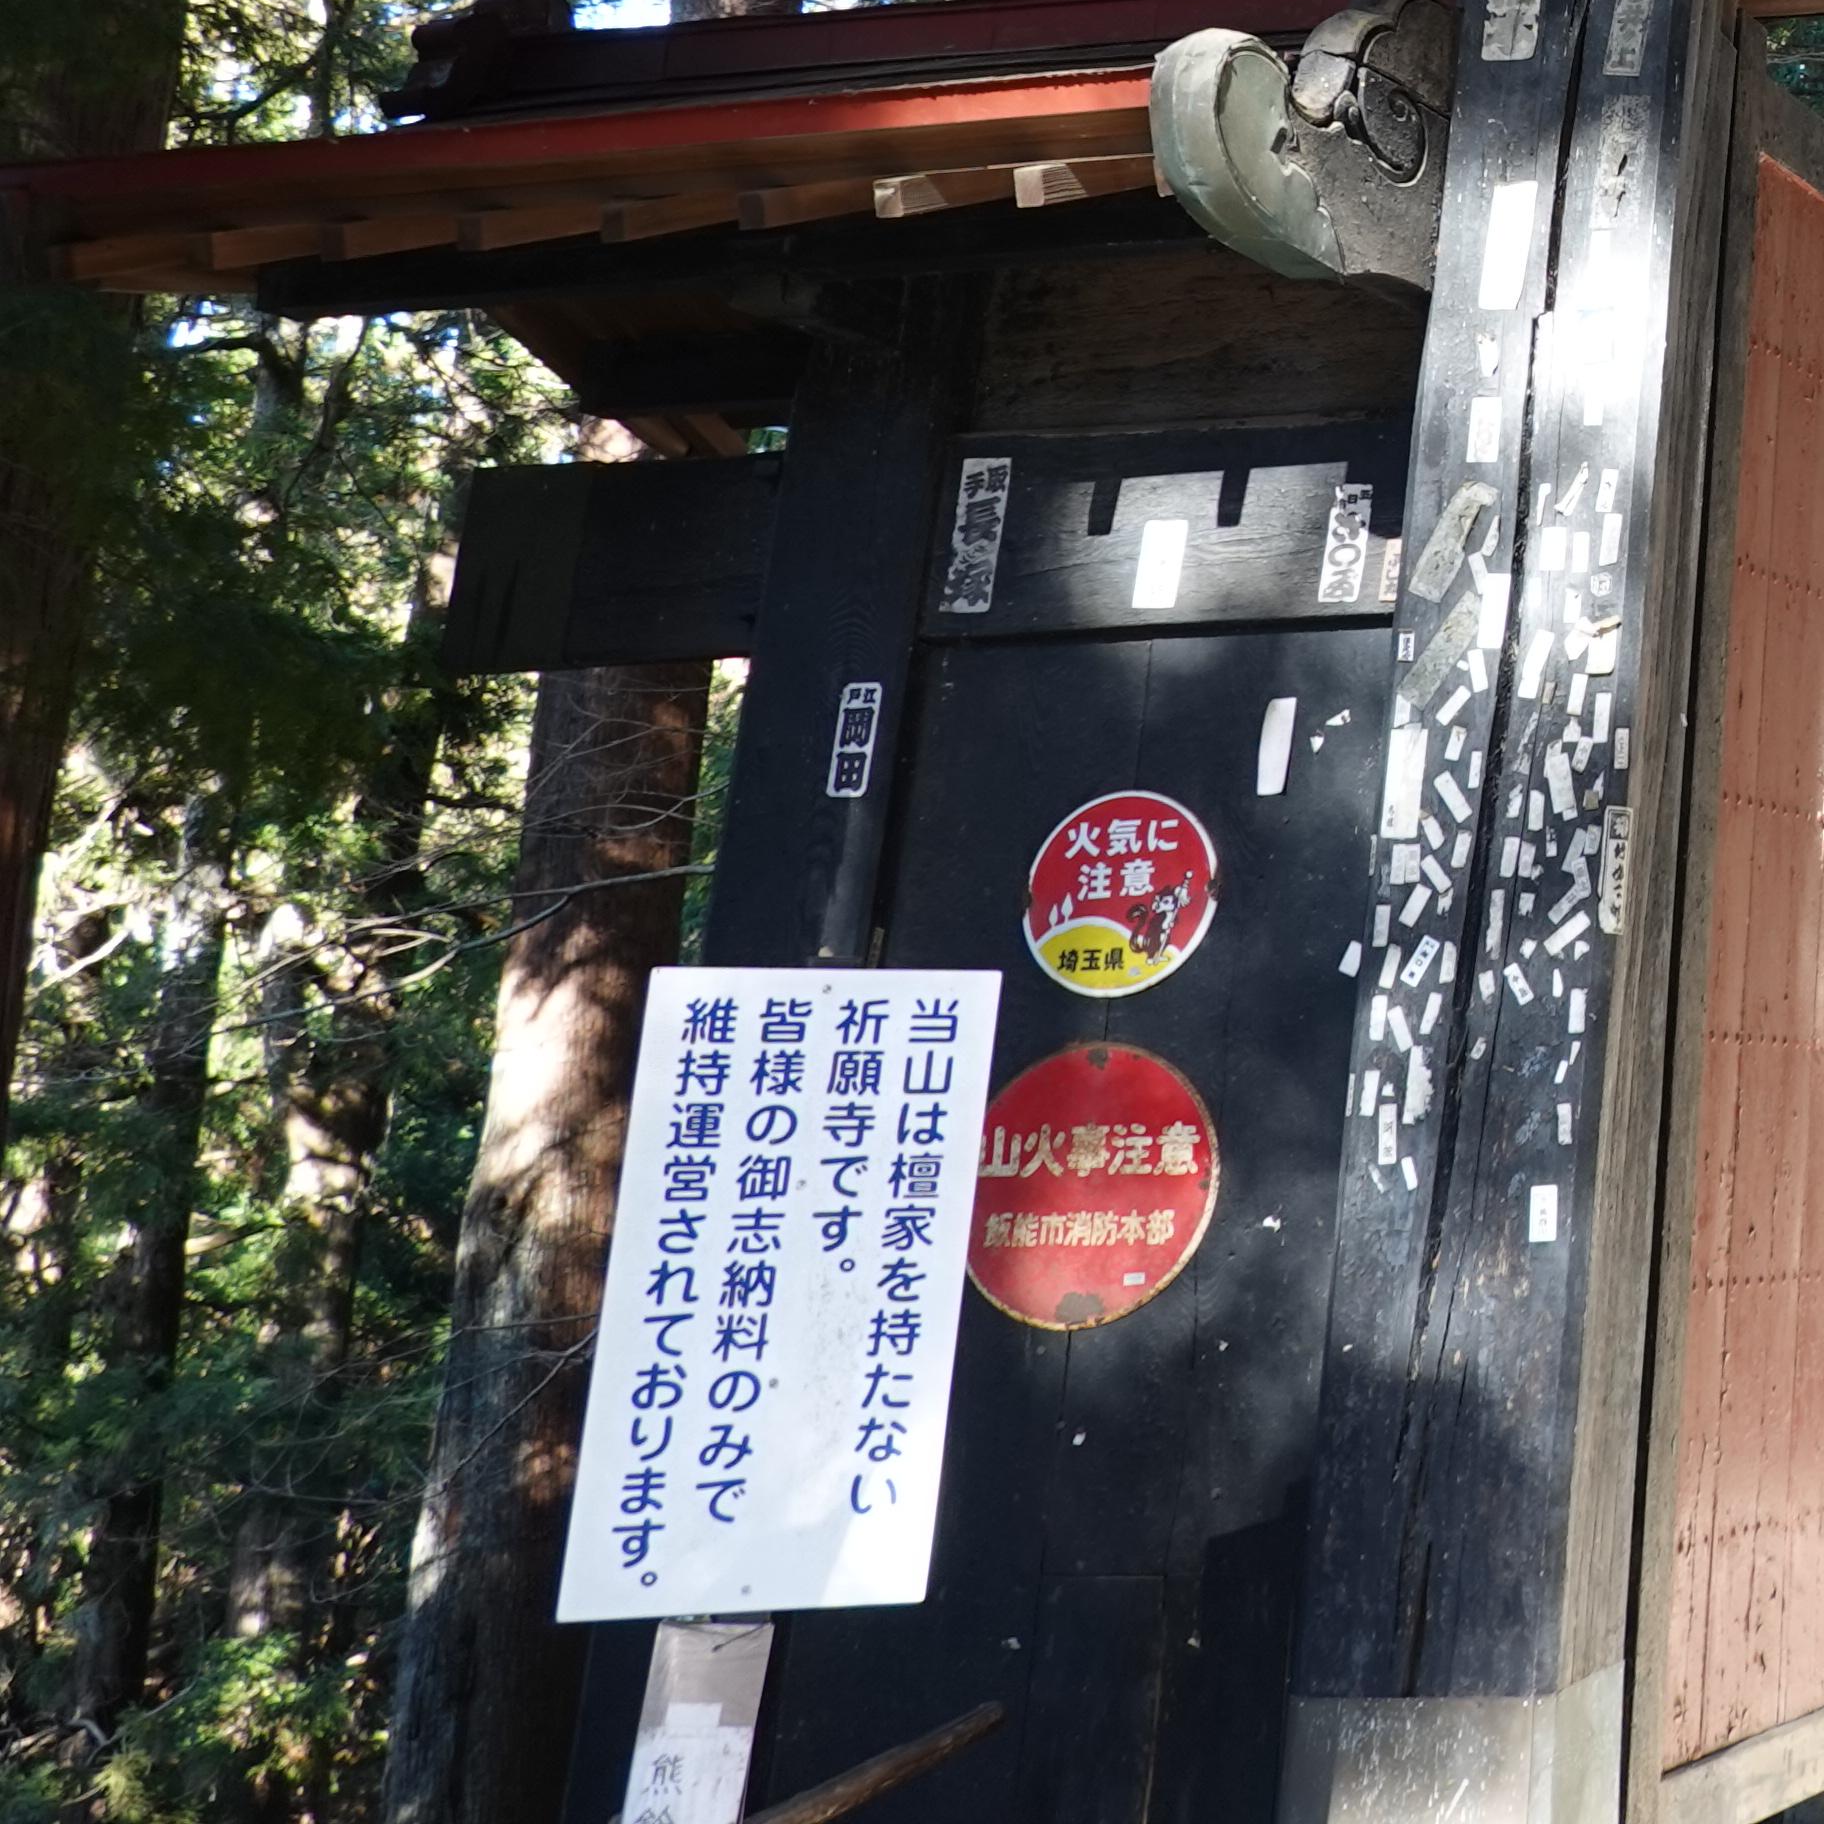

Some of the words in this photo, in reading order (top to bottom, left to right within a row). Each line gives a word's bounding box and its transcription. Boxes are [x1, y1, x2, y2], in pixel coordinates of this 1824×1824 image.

[1064, 817, 1180, 860] 火気に
[1077, 859, 1157, 903] 注意
[1056, 947, 1125, 974] 埼玉県
[812, 997, 890, 1274] 祈願寺です。
[979, 1120, 1202, 1178] 山火事注意
[849, 996, 960, 1516] 当山は檀家を持たない
[982, 1207, 1177, 1250] 飯能市消防本部
[695, 998, 814, 1523] 皆様の御志納料のみで
[612, 996, 740, 1589] 維持運営されております。
